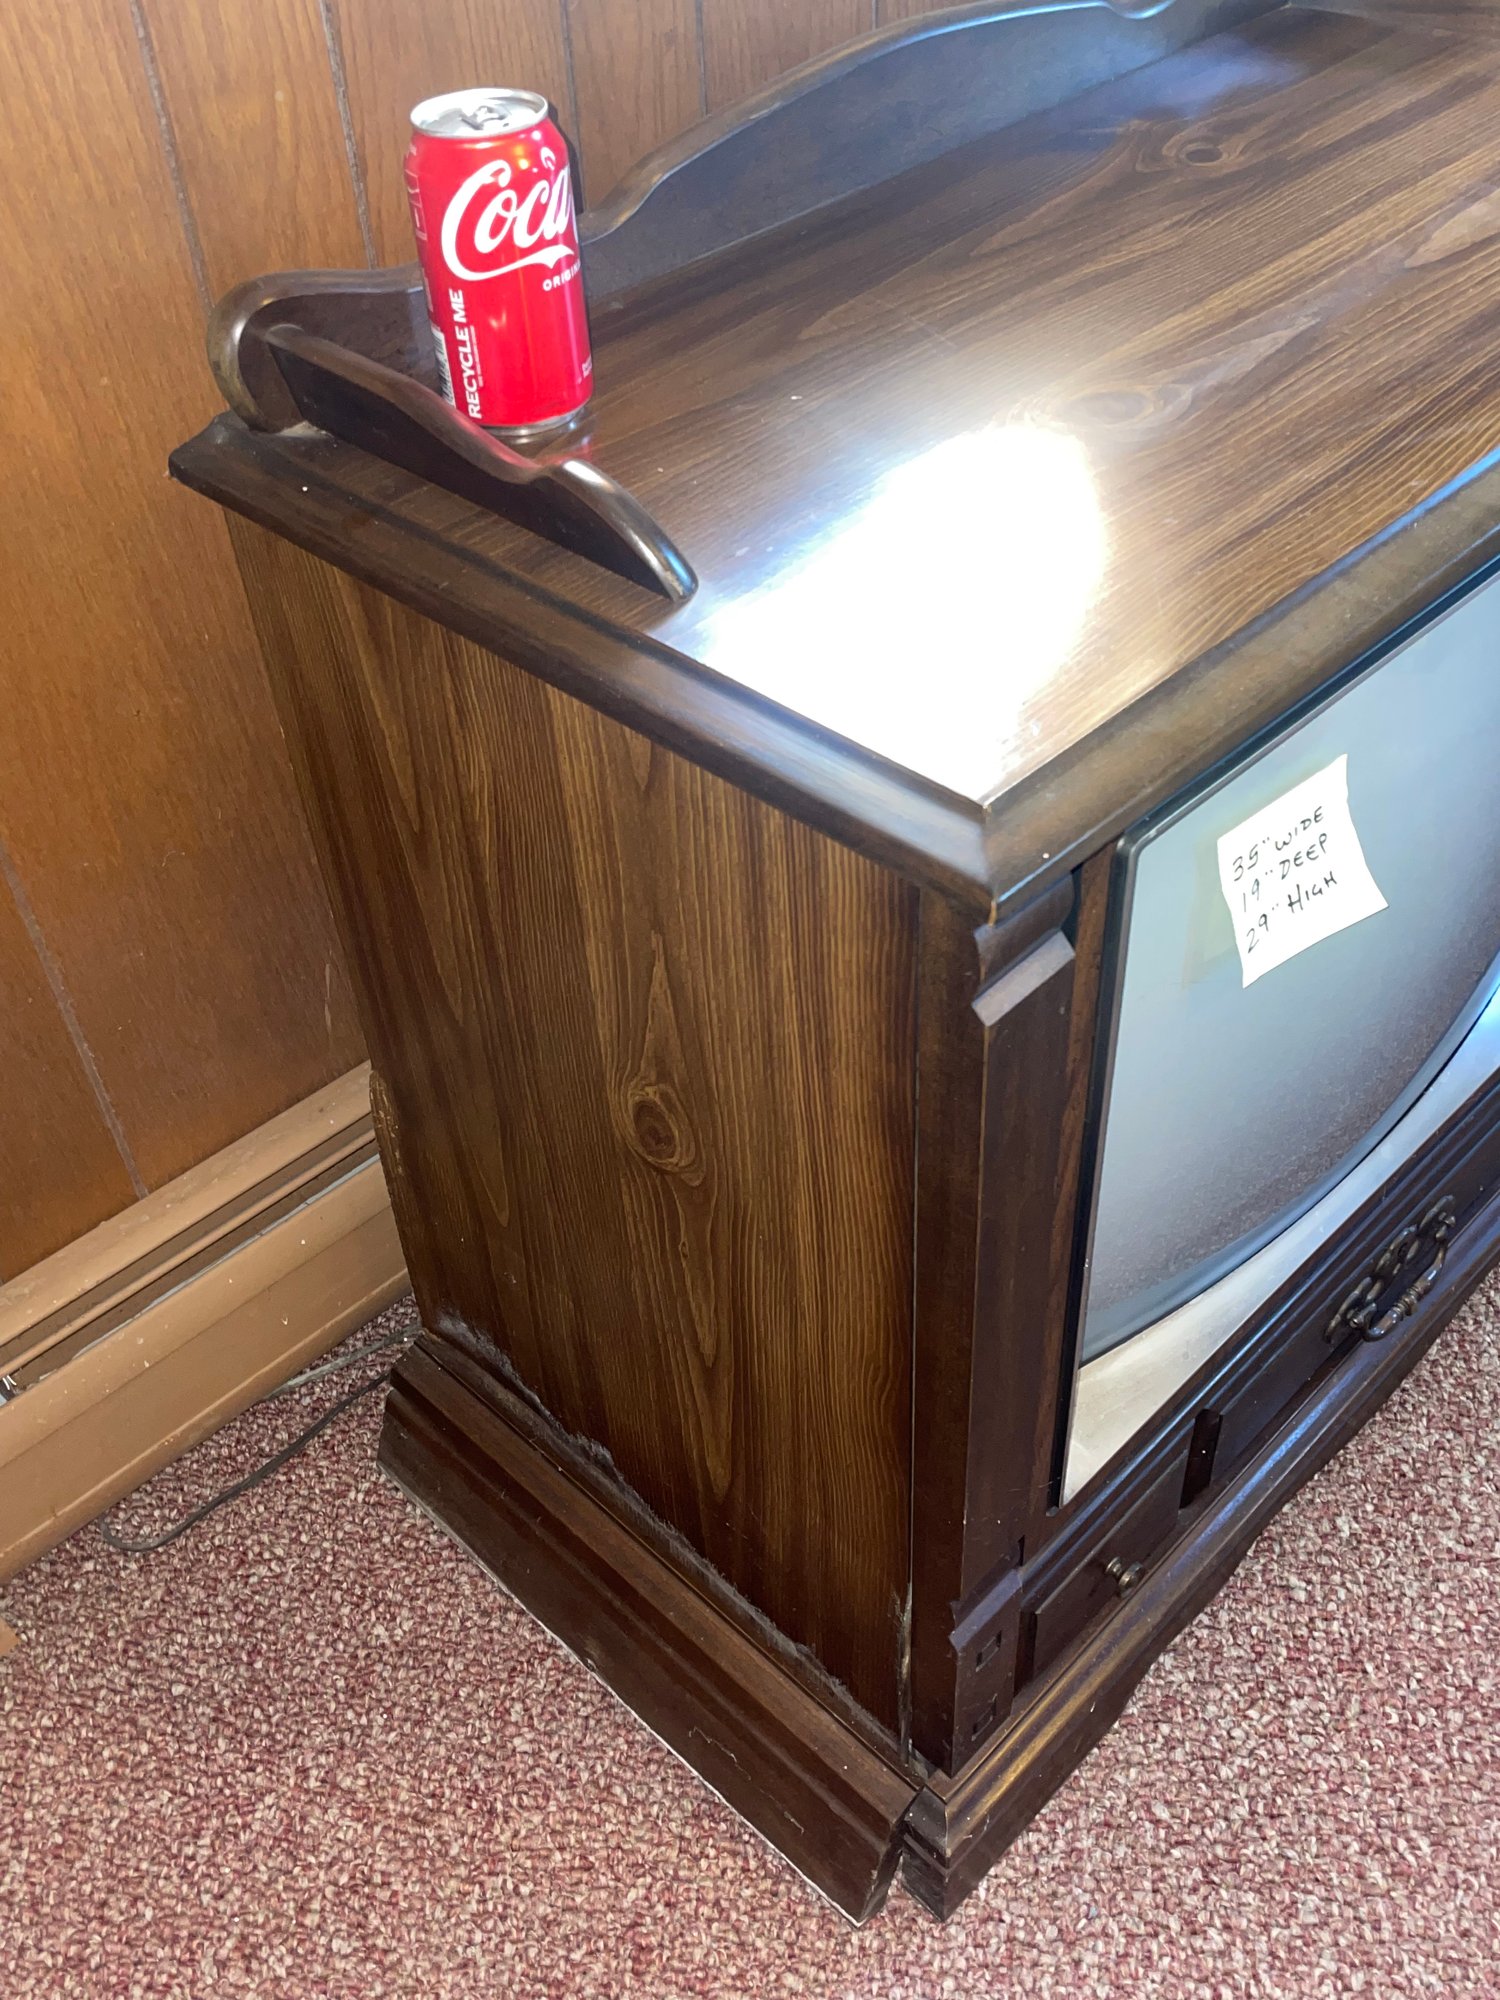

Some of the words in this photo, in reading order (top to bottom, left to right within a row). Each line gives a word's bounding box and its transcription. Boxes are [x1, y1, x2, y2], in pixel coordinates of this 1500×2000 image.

[449, 287, 467, 323] ME
[455, 325, 482, 419] RECYCLE
[1275, 805, 1324, 852] WIDE
[1279, 832, 1328, 881] DEEP
[1286, 870, 1338, 914] HIGH
